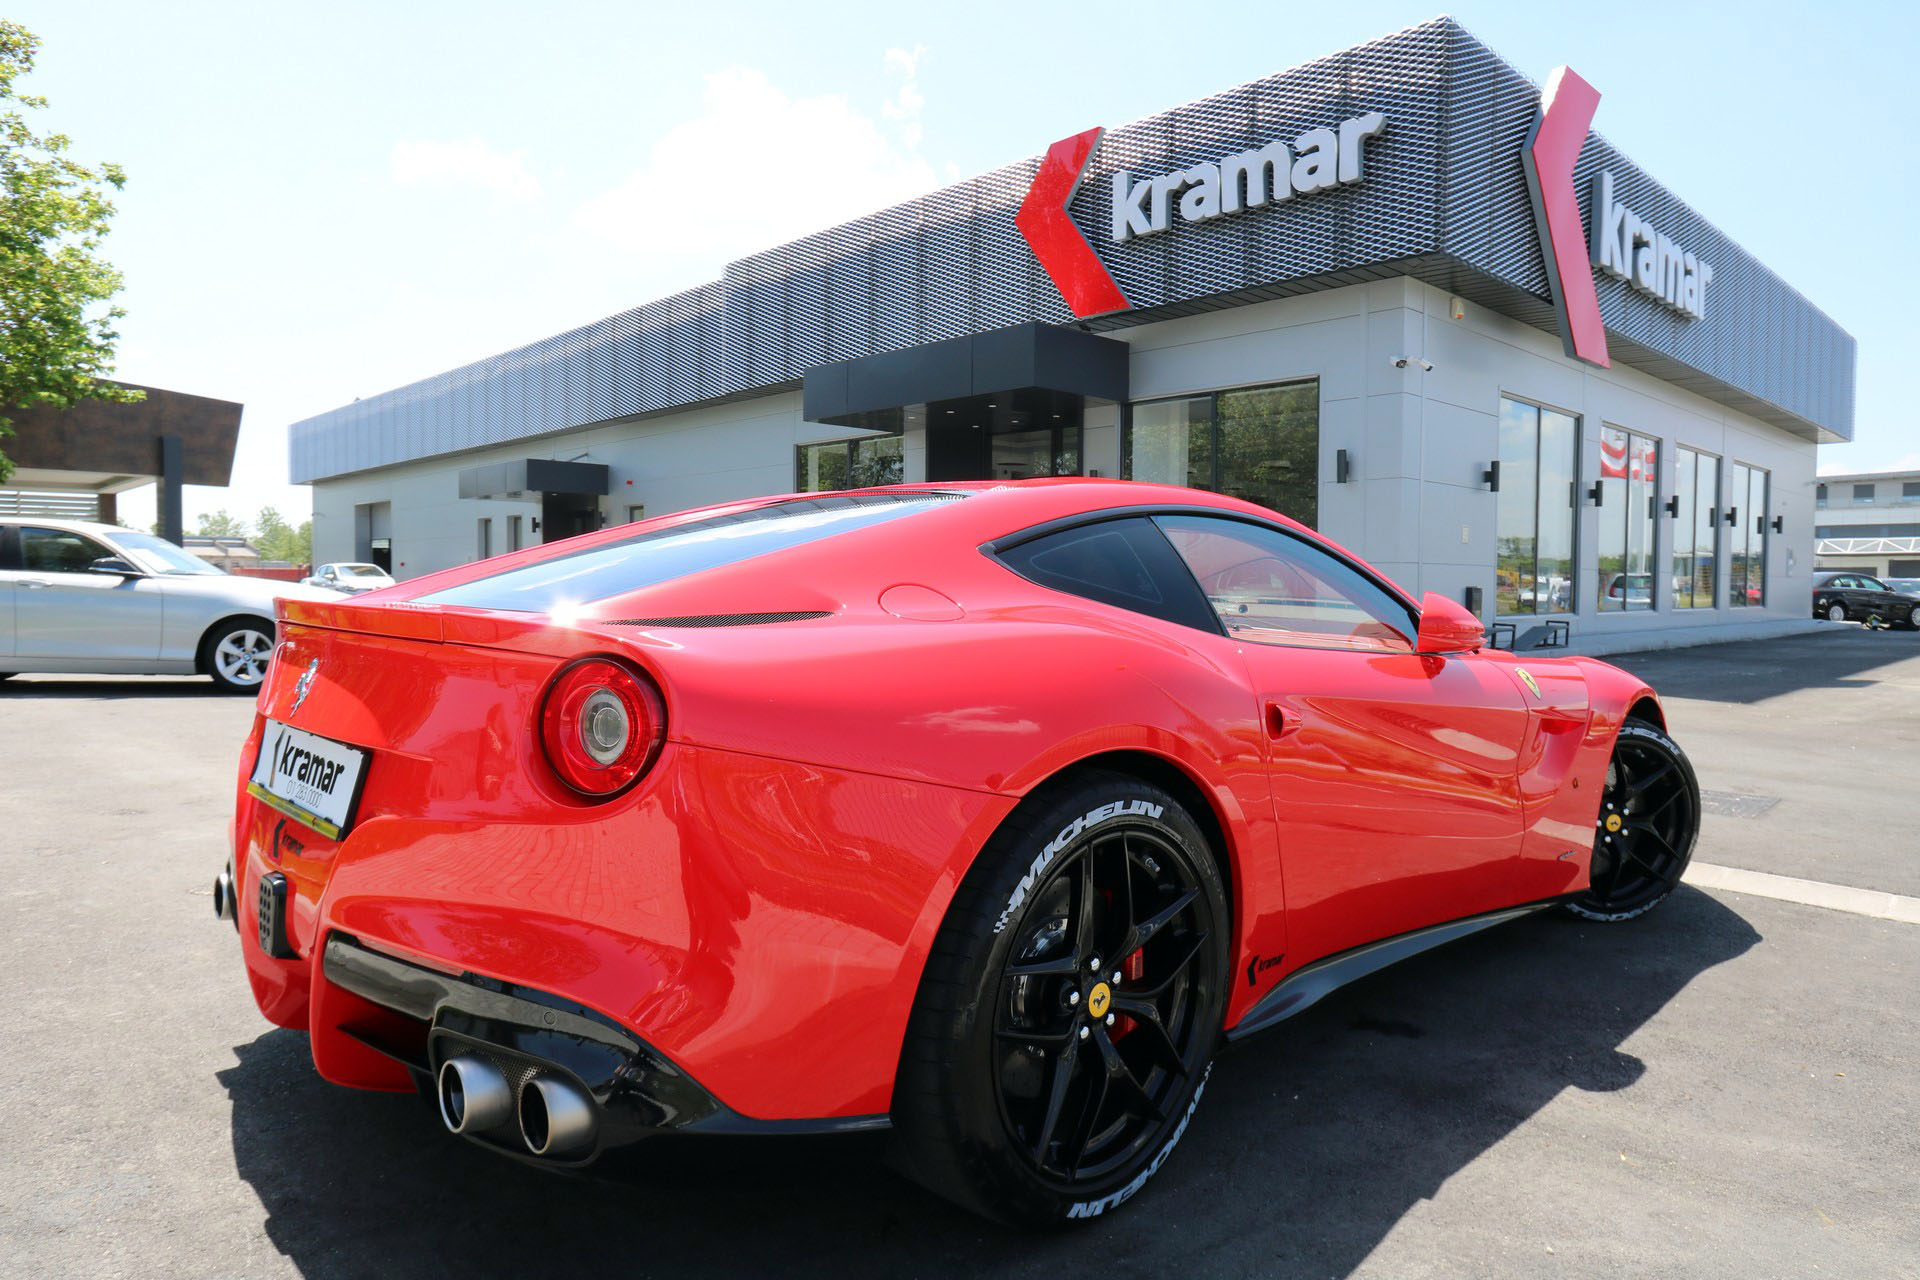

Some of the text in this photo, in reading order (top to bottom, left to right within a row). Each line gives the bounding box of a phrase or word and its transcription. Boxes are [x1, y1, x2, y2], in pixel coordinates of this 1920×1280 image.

[1112, 112, 1388, 241] kramar
[1592, 171, 1713, 320] kramar
[279, 734, 345, 795] kramar
[1007, 800, 1164, 913] MICHELIN
